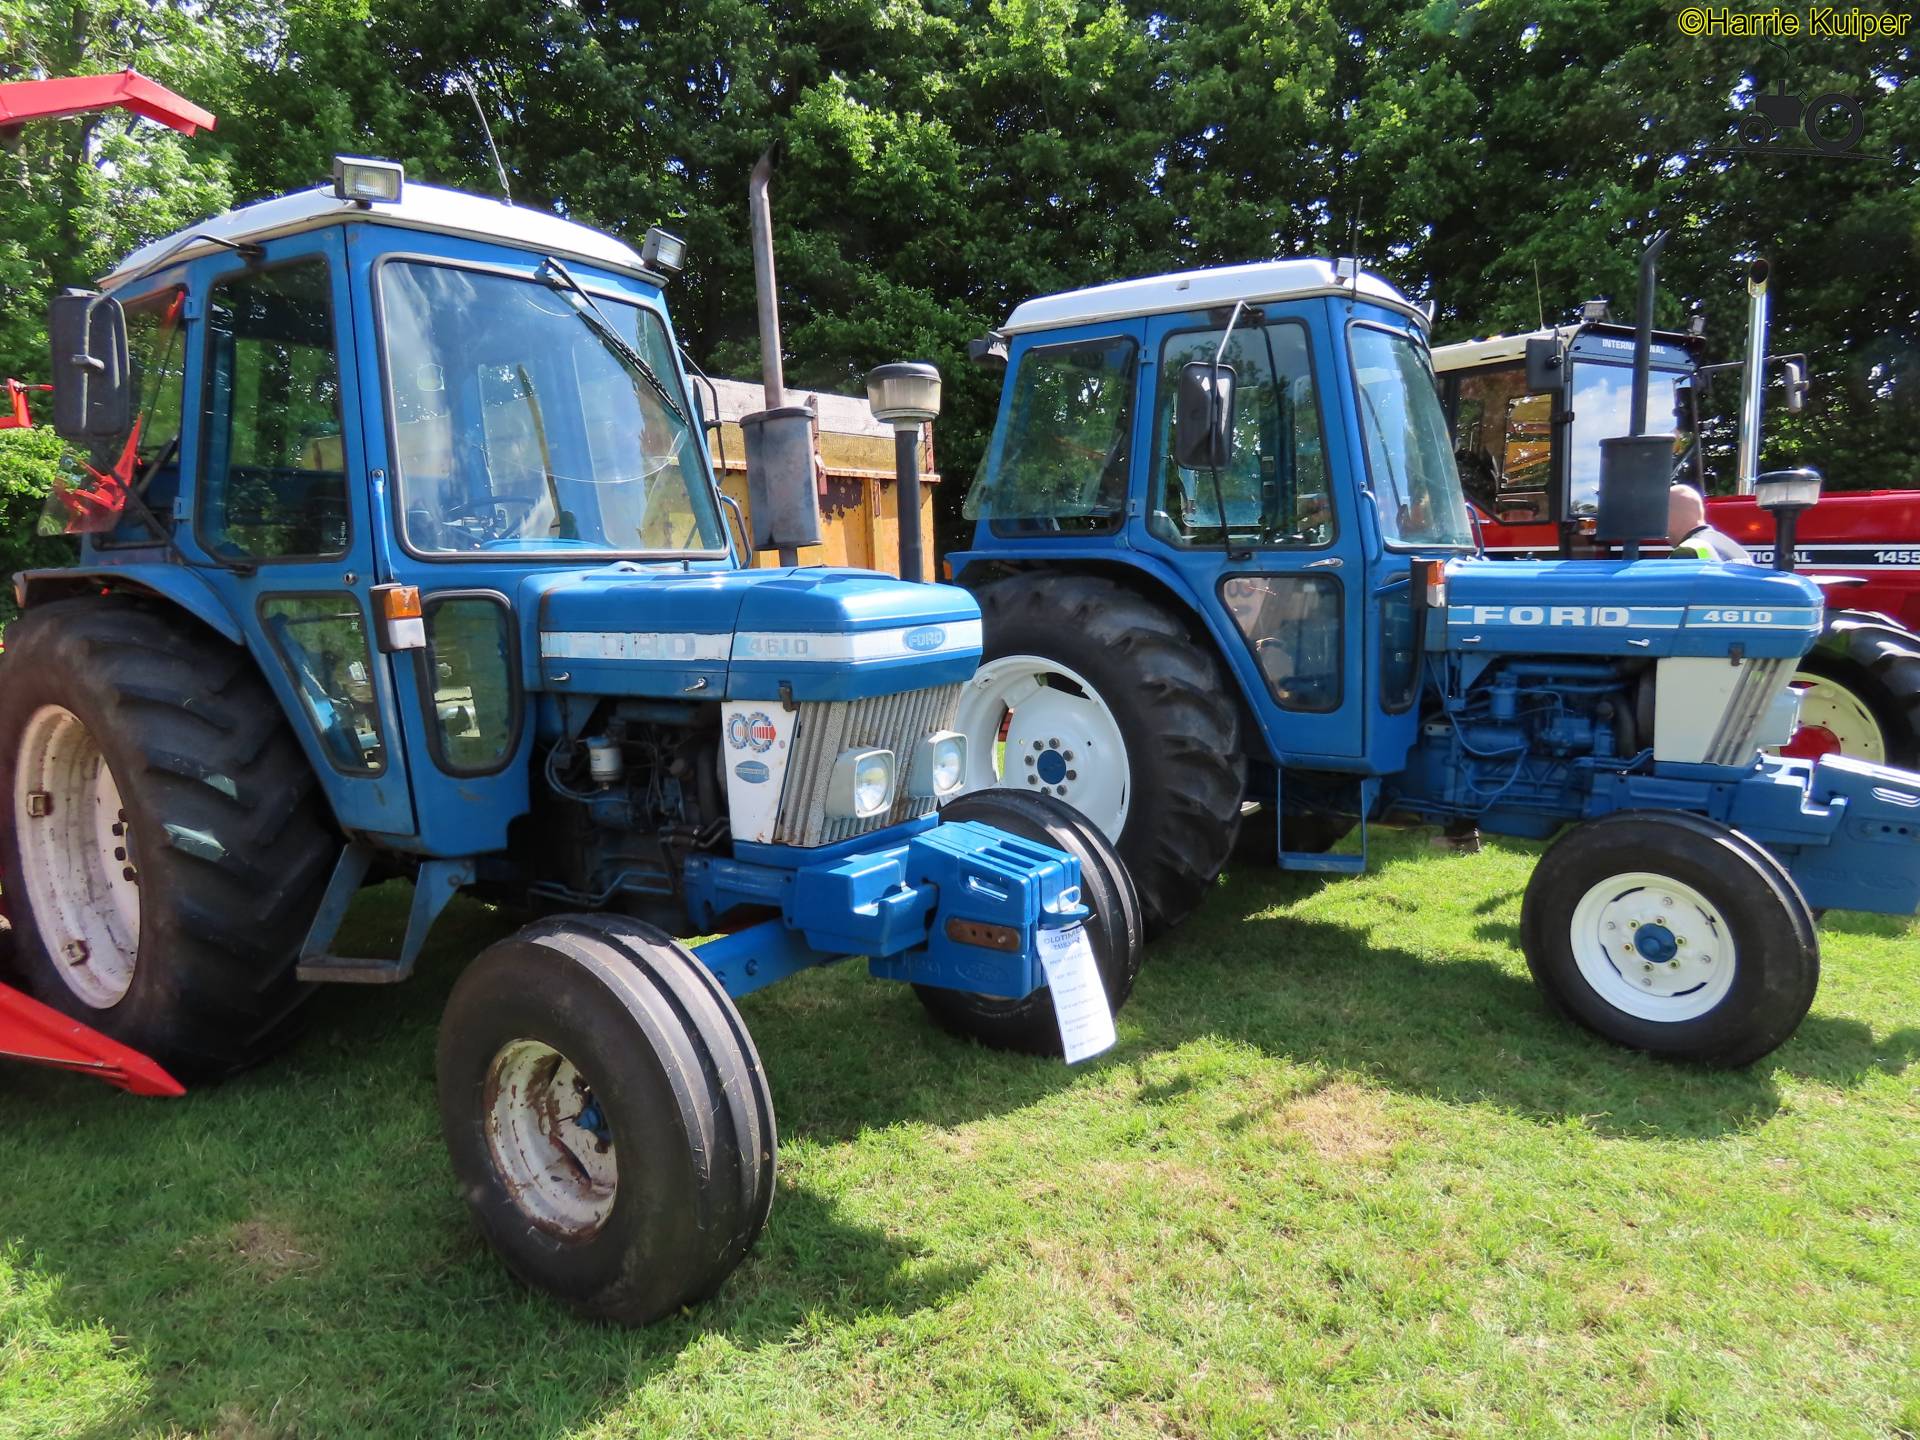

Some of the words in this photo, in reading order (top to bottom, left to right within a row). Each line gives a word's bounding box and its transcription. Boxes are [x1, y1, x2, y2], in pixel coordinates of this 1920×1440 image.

[1873, 551, 1920, 563] 1455
[1473, 606, 1630, 627] FORD
[1703, 610, 1772, 623] 4610
[748, 638, 809, 655] 4610
[911, 631, 943, 647] FORD
